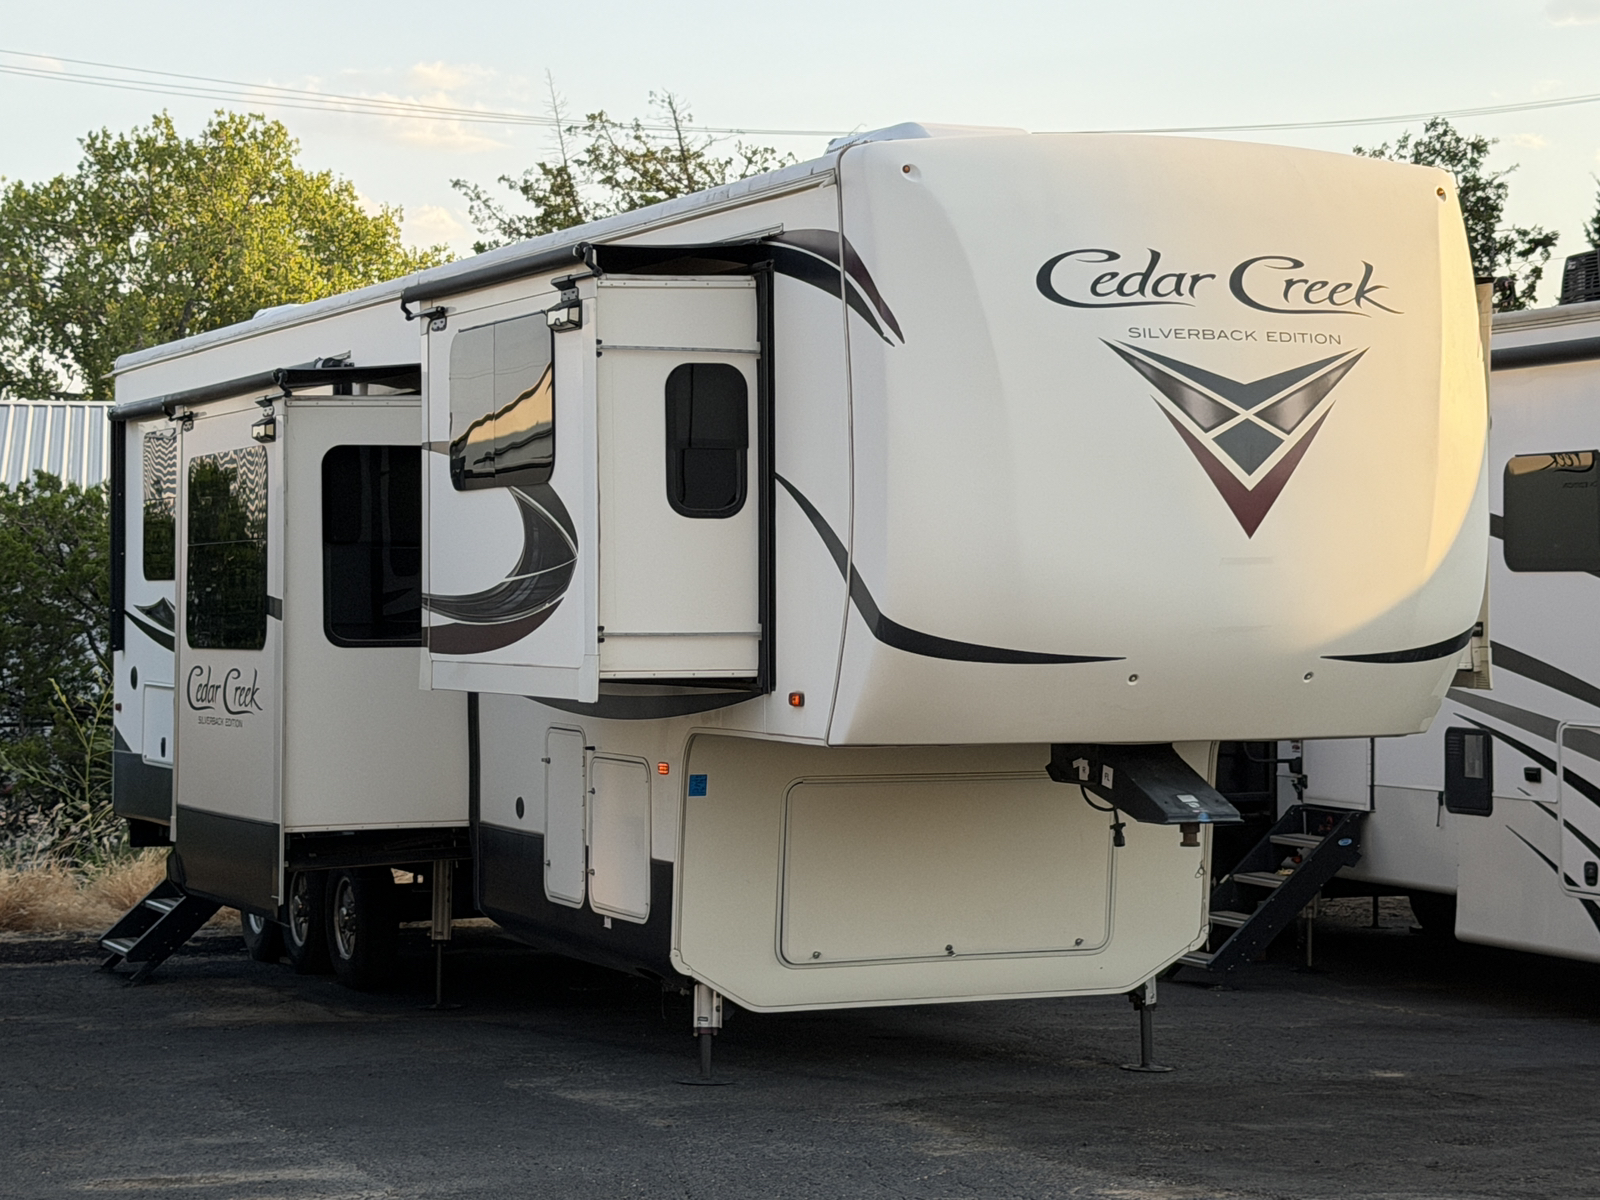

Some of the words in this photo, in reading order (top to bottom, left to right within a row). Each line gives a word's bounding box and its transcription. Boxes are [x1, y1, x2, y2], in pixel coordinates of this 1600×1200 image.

[1036, 248, 1216, 308] Cedar
[1229, 255, 1405, 318] Creek
[1128, 327, 1258, 342] SILVERBACK
[1266, 331, 1342, 345] EDITION
[187, 665, 221, 711] Cedar
[223, 667, 263, 715] Creek
